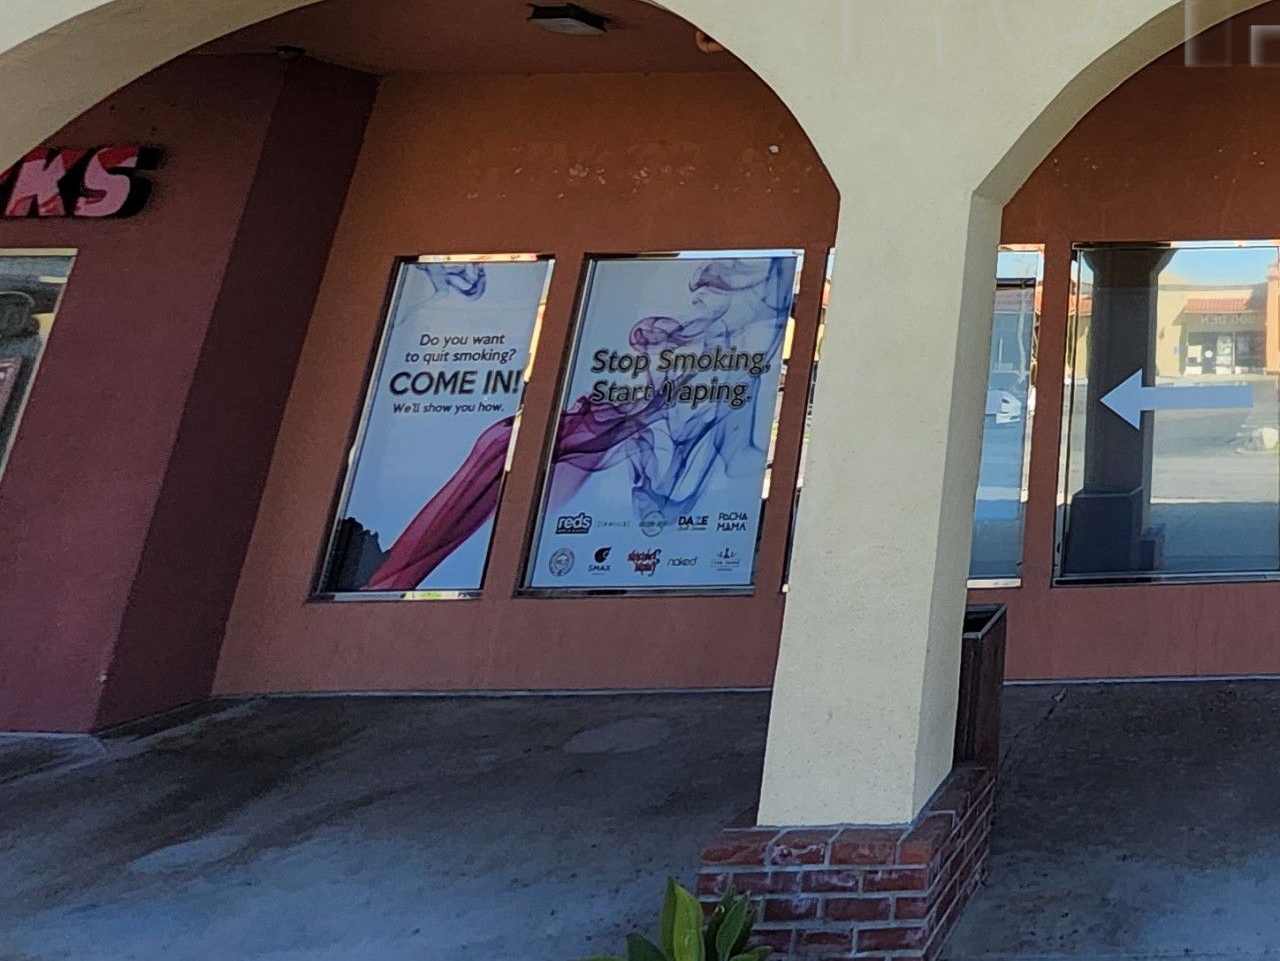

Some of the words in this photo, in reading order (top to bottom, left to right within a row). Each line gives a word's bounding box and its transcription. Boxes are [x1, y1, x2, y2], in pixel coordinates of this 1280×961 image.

[0, 145, 158, 219] KS
[419, 333, 440, 347] Do
[444, 335, 468, 349] you
[473, 334, 506, 346] want
[405, 352, 420, 363] to
[423, 349, 450, 365] quit
[453, 349, 517, 365] smoking?
[590, 348, 650, 379] Stop
[656, 344, 771, 376] Smoking,
[389, 369, 478, 397] COME
[482, 369, 524, 395] IN!
[590, 379, 653, 404] Start
[423, 401, 451, 413] show
[454, 403, 475, 415] you
[557, 514, 592, 529] reds
[667, 557, 698, 567] naked
